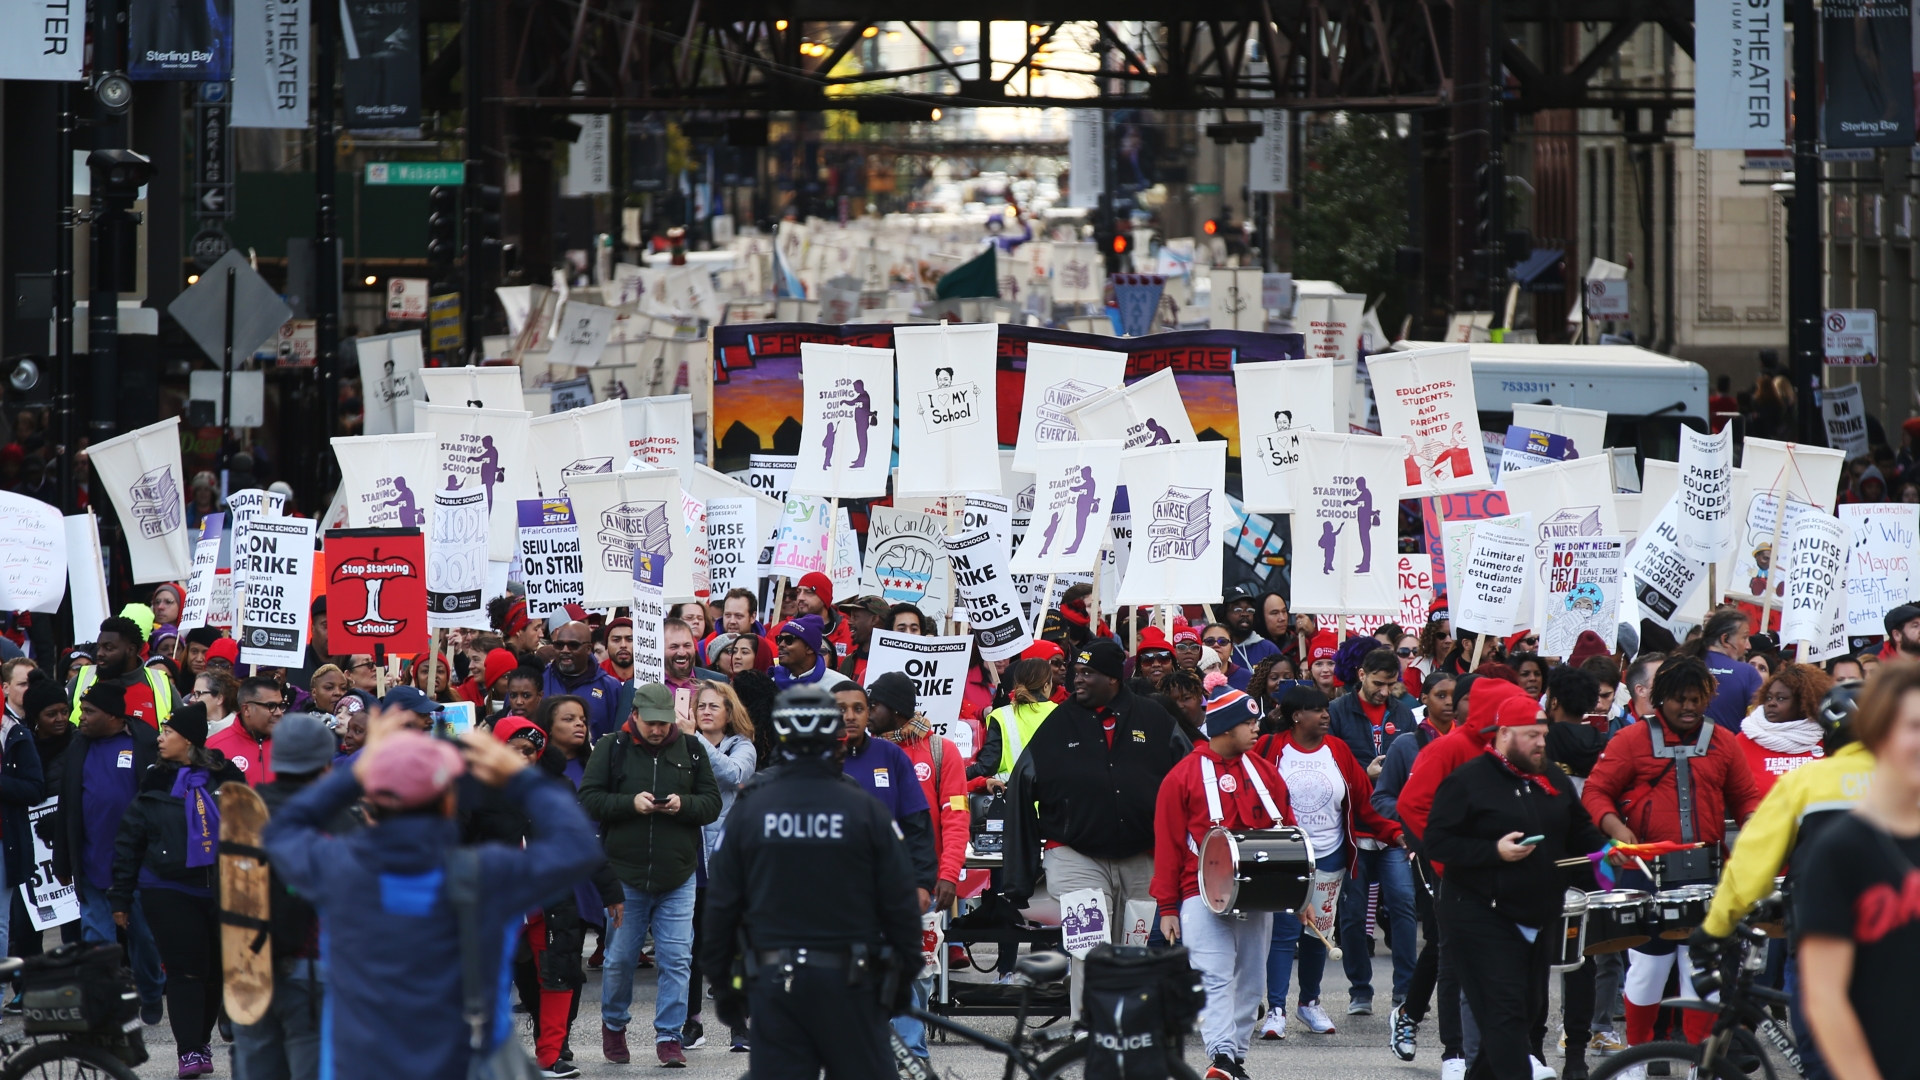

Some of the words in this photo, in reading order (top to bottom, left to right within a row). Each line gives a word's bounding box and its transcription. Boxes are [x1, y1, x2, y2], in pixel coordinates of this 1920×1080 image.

[1824, 6, 1854, 18] Pina
[1858, 5, 1908, 18] Bausch
[264, 31, 274, 64] PARK
[146, 51, 189, 63] Sterling
[191, 51, 214, 63] Bay
[278, 10, 298, 110] THEATER
[1732, 38, 1742, 78] PARK
[1748, 13, 1770, 128] THEATER
[356, 105, 388, 116] Sterling
[390, 105, 408, 115] Bay
[1841, 122, 1878, 132] Sterling
[1880, 120, 1899, 131] Bay
[206, 108, 221, 182] PARKING
[399, 165, 448, 179] Wabash
[1396, 380, 1456, 396] EDUCATORS,
[1502, 382, 1550, 392] 7533311
[928, 394, 935, 408] I
[952, 390, 968, 406] MY
[1048, 391, 1054, 402] A
[1402, 391, 1453, 406] STUDENTS,
[822, 410, 854, 420] SCHOOLS
[932, 403, 970, 424] School
[1418, 405, 1436, 416] AND
[1833, 401, 1850, 416] ON
[1410, 412, 1450, 426] PARENTS
[1828, 416, 1864, 434] STRIKE
[1040, 428, 1066, 441] EVERY
[1127, 422, 1145, 436] STOP
[1416, 424, 1448, 436] UNITED
[460, 434, 481, 442] STOP
[630, 437, 680, 448] EDUCATORS,
[1267, 438, 1274, 450] I
[440, 443, 483, 454] STARVING
[634, 447, 676, 457] STUDENTS,
[1526, 443, 1548, 452] SEIU
[448, 454, 467, 464] OUR
[1272, 450, 1298, 466] Scho
[442, 462, 480, 475] SCHOOLS
[750, 474, 774, 488] ON
[1333, 476, 1354, 484] STOP
[1312, 487, 1358, 496] STARVING
[462, 495, 483, 504] SCHOOLS
[1322, 498, 1342, 508] OUR
[986, 502, 1008, 512] SCHOOLS
[1156, 506, 1162, 518] A
[1316, 509, 1356, 518] SCHOOLS
[1756, 507, 1771, 515] have
[544, 514, 570, 522] SEIU
[606, 514, 613, 526] A
[615, 516, 644, 534] NURSE
[964, 512, 988, 528] ON
[1754, 515, 1770, 524] they
[1811, 518, 1836, 530] SCHOOLS
[275, 525, 306, 533] SCHOOLS
[872, 515, 891, 538] We
[894, 514, 916, 534] Can
[919, 515, 936, 536] Do
[1544, 526, 1550, 538] A
[1796, 524, 1820, 532] STUDENTS
[960, 533, 988, 546] SCHOOLS
[1114, 528, 1132, 539] We
[1880, 522, 1912, 550] Why
[250, 536, 278, 554] ON
[522, 540, 548, 554] SEIU
[552, 538, 580, 552] Local
[608, 537, 623, 546] EVERY
[1554, 542, 1566, 550] WE
[1568, 542, 1588, 550] DON'T
[1592, 542, 1612, 550] NEED
[1174, 541, 1191, 557] DAY
[1476, 547, 1515, 562] ¡Limitar
[1517, 554, 1524, 562] el
[1670, 548, 1686, 562] contra
[1792, 542, 1796, 553] A
[1800, 538, 1841, 561] NURSE
[196, 554, 214, 564] this
[1473, 558, 1511, 572] número
[1513, 564, 1523, 573] de
[1553, 552, 1574, 568] NO
[1646, 542, 1696, 582] PRACTICAS
[1790, 554, 1798, 569] IN
[1802, 552, 1839, 576] EVERY
[1858, 551, 1908, 577] Mayors
[342, 564, 364, 576] Stop
[366, 564, 410, 576] Starving
[525, 562, 543, 576] On
[640, 571, 650, 580] SEIU
[1468, 568, 1522, 584] estudiantes
[1552, 568, 1572, 582] HEY
[1644, 555, 1686, 588] INJUSTAS
[1599, 576, 1618, 584] ALONE
[1634, 561, 1682, 600] LABORALES
[1790, 567, 1834, 591] SCHOOL
[526, 580, 542, 594] for
[545, 579, 584, 596] Chicag
[1476, 582, 1488, 590] en
[1492, 584, 1512, 594] cada
[1792, 582, 1830, 601] EVERY
[1847, 578, 1888, 595] GREAT
[1400, 594, 1421, 608] to
[1478, 592, 1506, 604] clase!
[1884, 587, 1910, 602] THEY
[642, 600, 648, 612] do
[649, 601, 662, 616] this
[1793, 597, 1824, 614] DAY!
[1849, 609, 1878, 625] Gotta
[357, 624, 394, 634] Schools
[646, 622, 656, 633] our
[636, 636, 656, 650] special
[882, 639, 914, 650] CHICAGO
[914, 644, 937, 652] PUBLIC
[938, 644, 964, 652] SCHOOLS
[635, 650, 662, 668] education
[636, 668, 661, 683] students!
[904, 659, 938, 678] ON
[1290, 760, 1327, 770] PSRPs
[764, 813, 844, 838] POLICE
[24, 1008, 82, 1021] POLICE
[1095, 1034, 1154, 1050] POLICE
